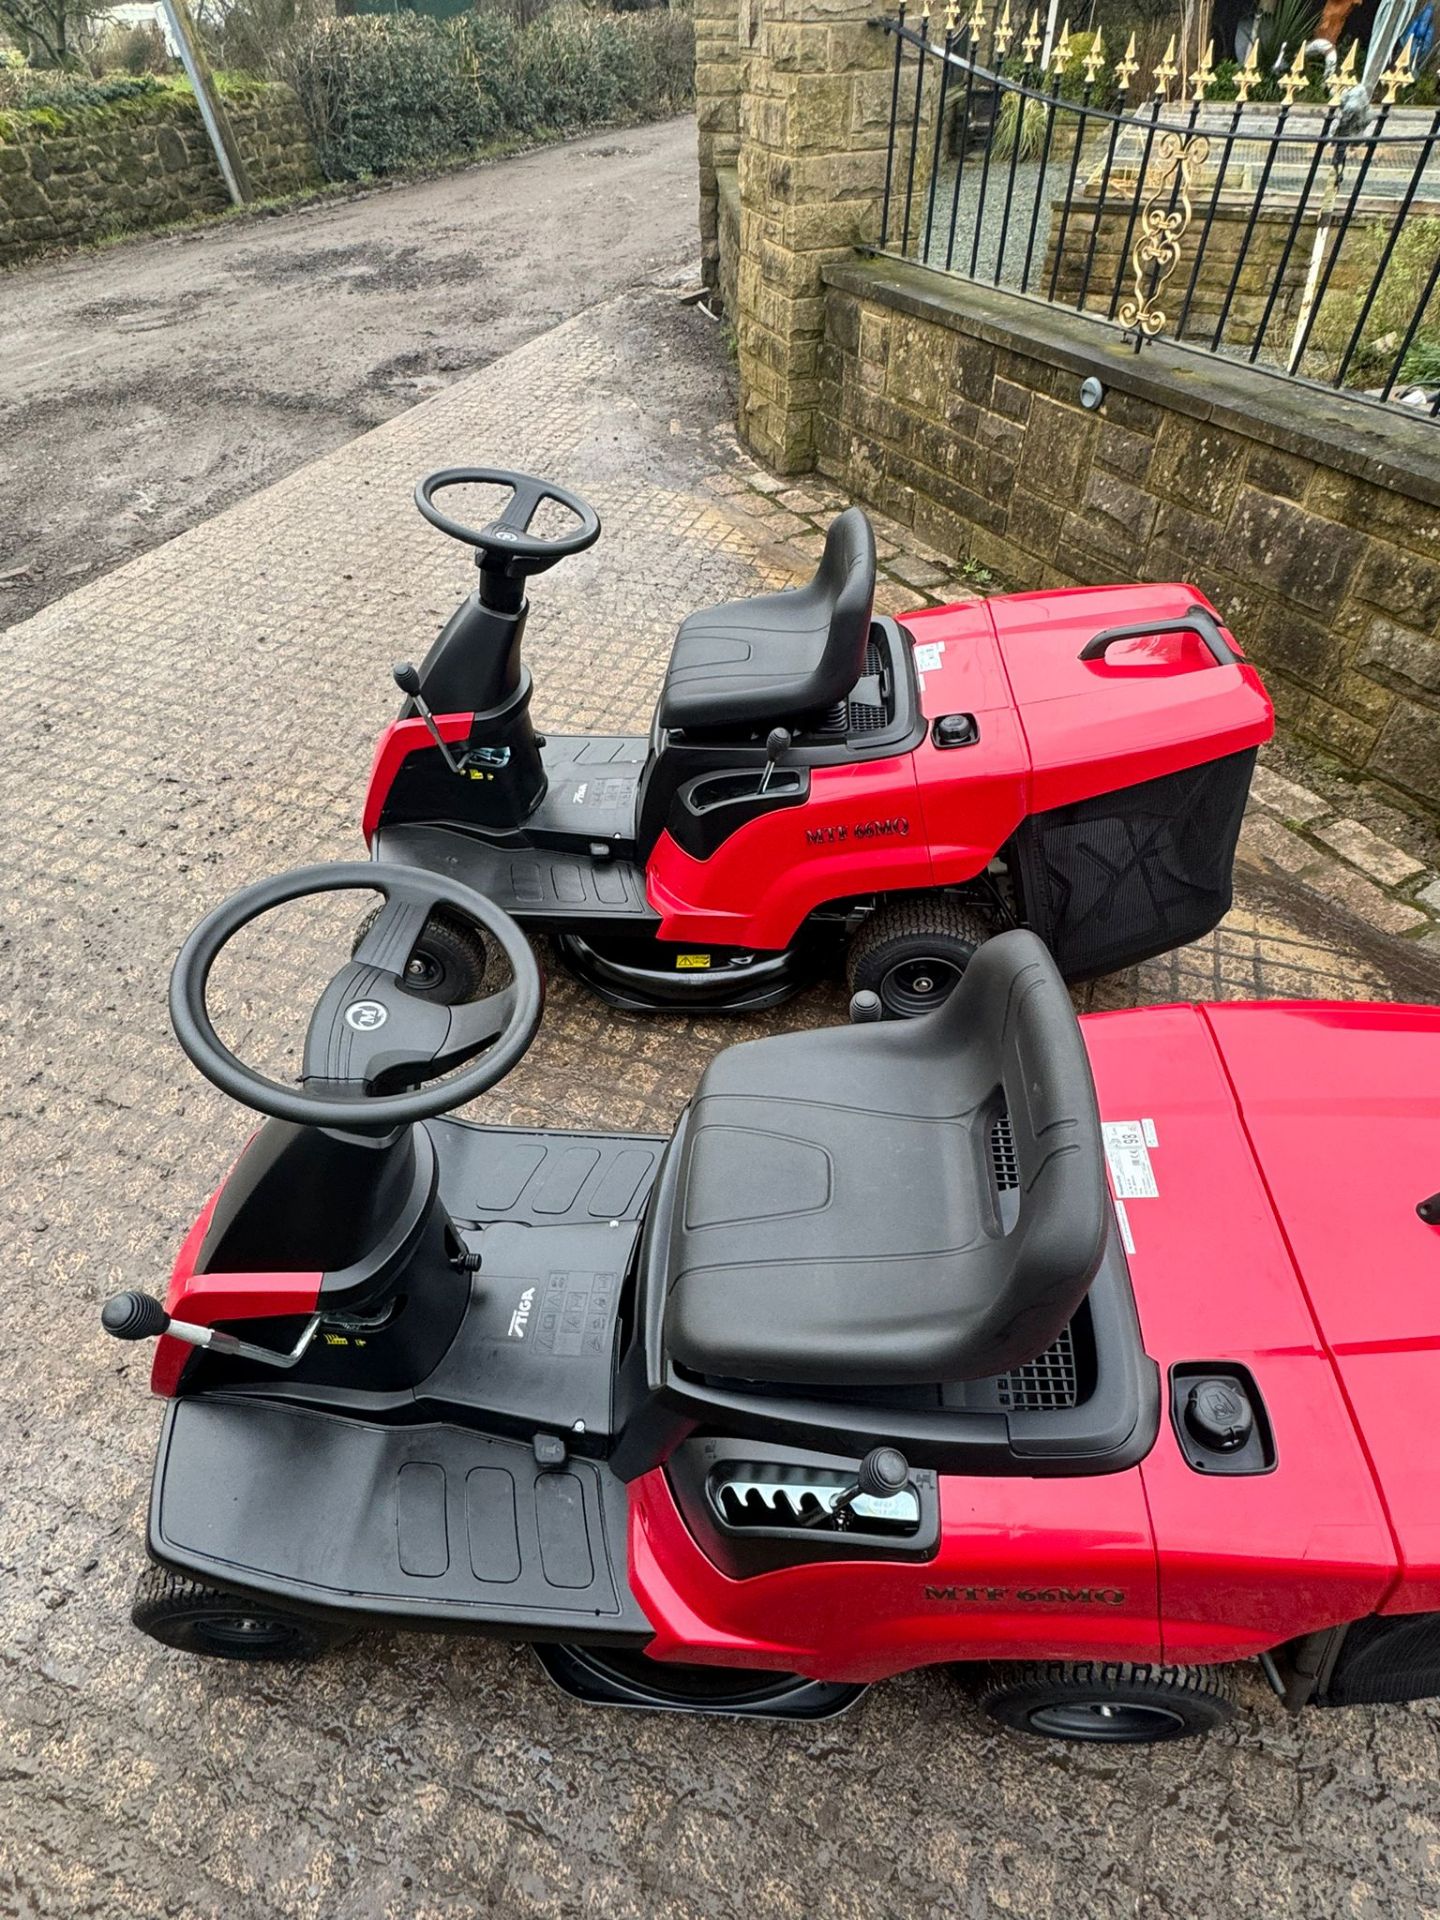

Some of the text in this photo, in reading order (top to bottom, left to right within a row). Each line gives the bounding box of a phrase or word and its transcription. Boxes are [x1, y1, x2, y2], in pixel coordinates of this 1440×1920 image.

[806, 817, 909, 844] MTF 66MQ
[508, 1287, 536, 1338] STIGA
[924, 1585, 1126, 1607] MTF 66MQ
